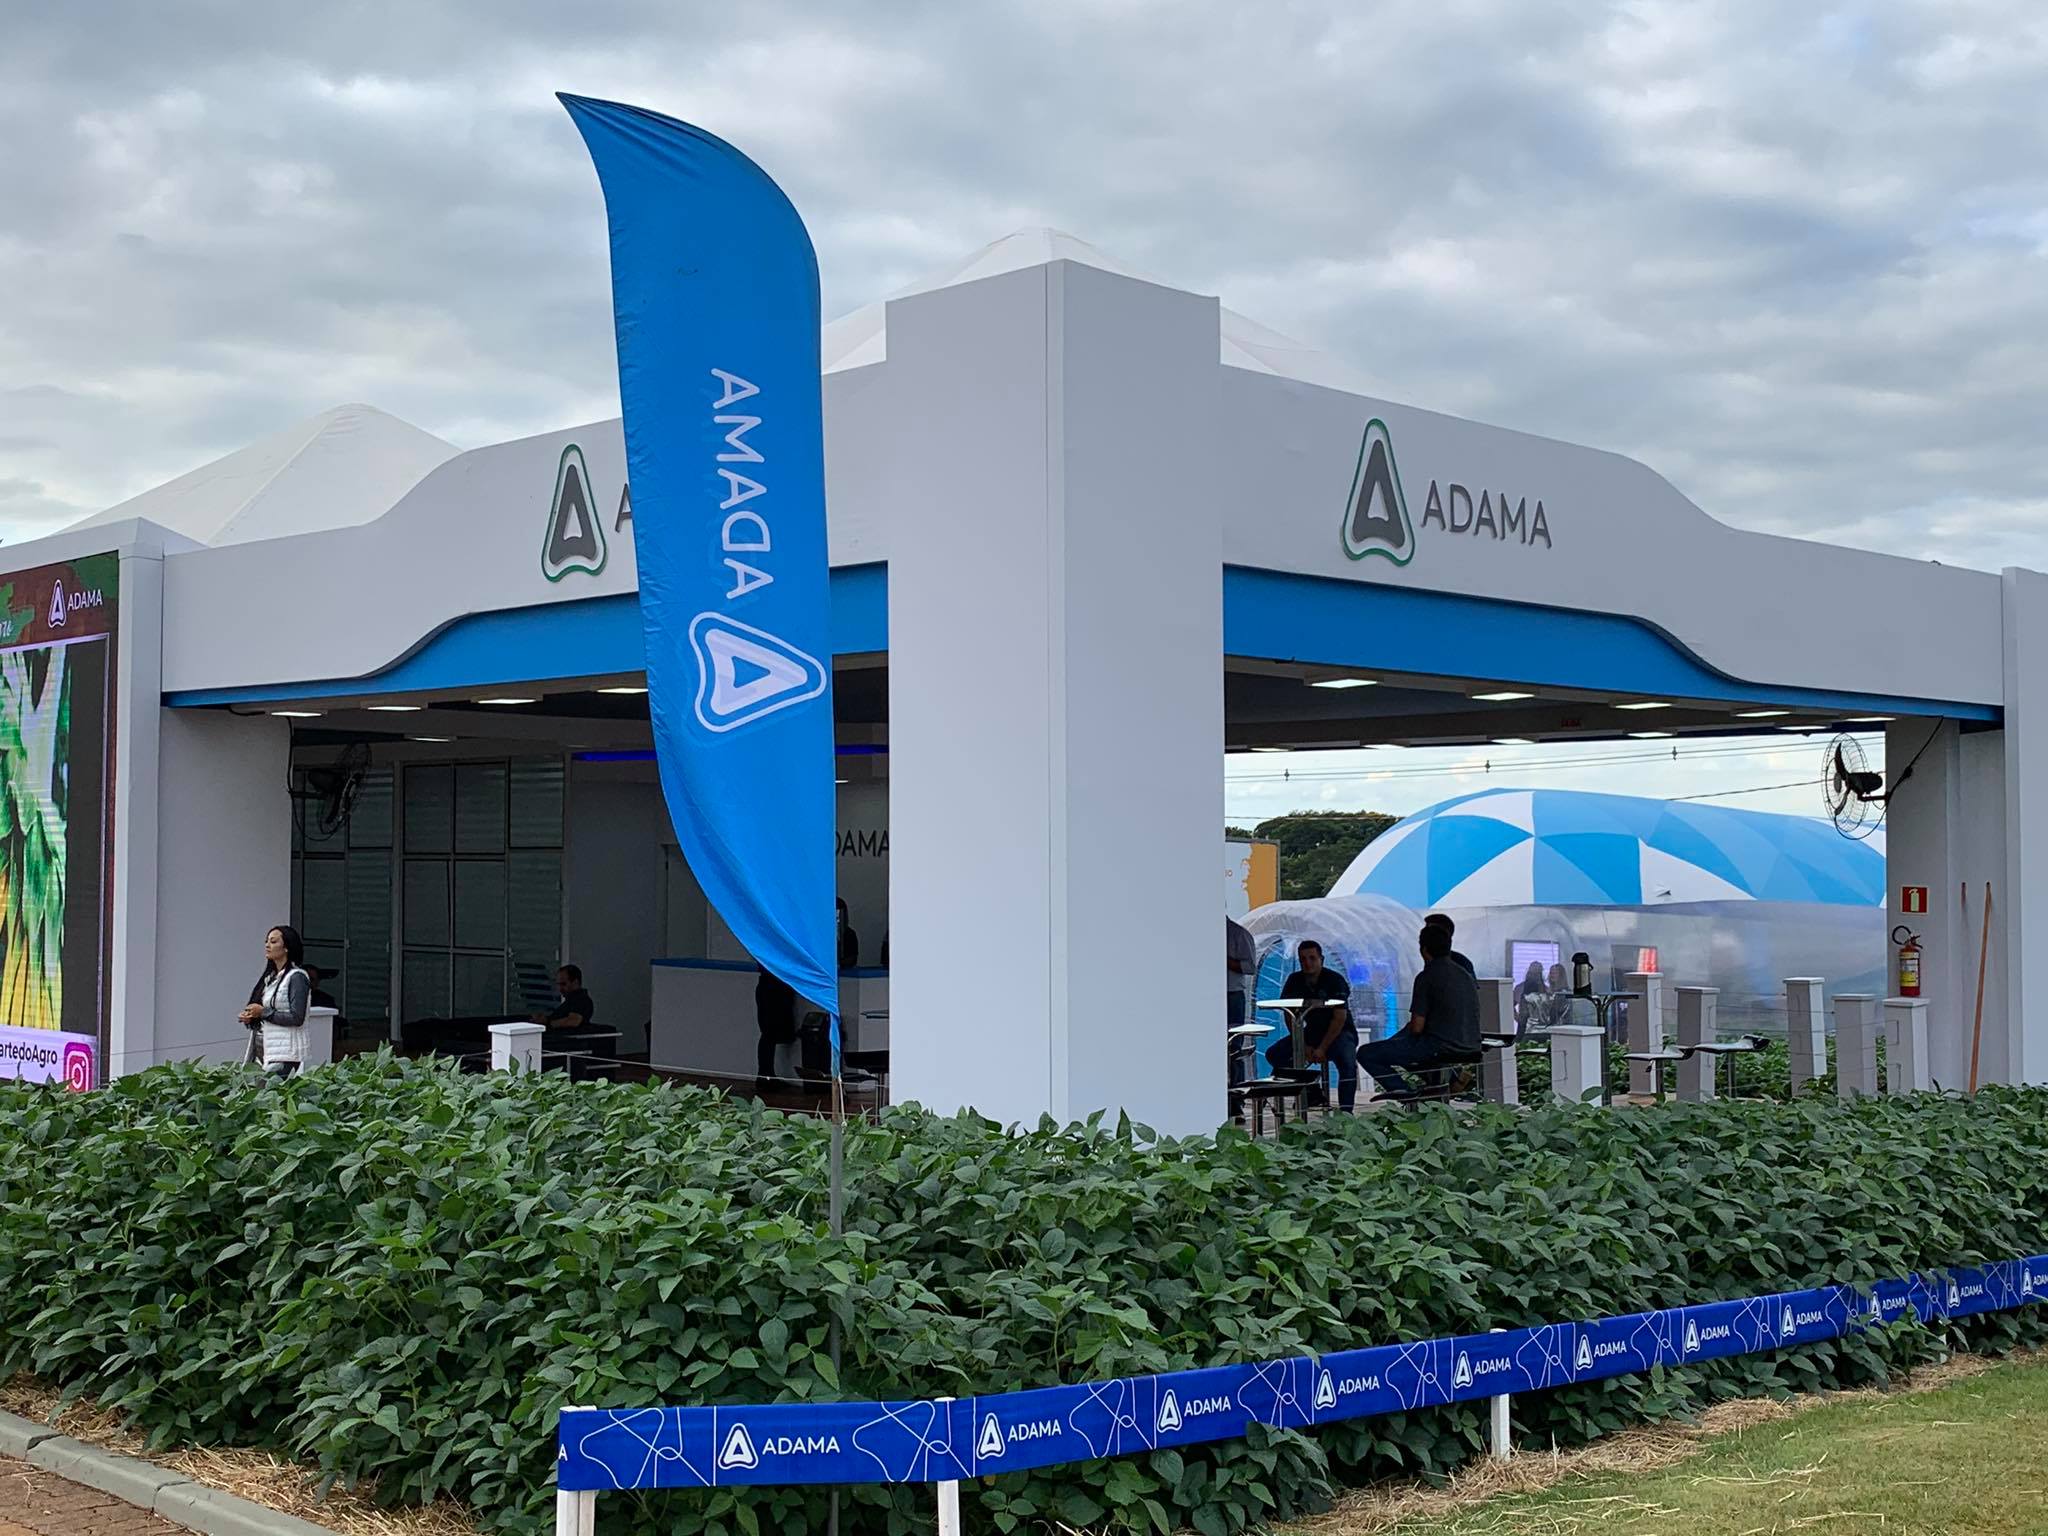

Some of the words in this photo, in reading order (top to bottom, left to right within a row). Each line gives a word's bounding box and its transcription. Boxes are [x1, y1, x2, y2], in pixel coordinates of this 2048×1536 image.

[1420, 479, 1552, 549] ADAMA
[67, 588, 103, 612] ADAMA
[1960, 1284, 1983, 1297] ADAMA
[1882, 1296, 1906, 1310] ADAMA
[1795, 1311, 1823, 1326] ADAMA
[1700, 1325, 1730, 1341] ADAMA
[1593, 1340, 1627, 1358] ADAMA
[1474, 1357, 1512, 1375] ADAMA
[1337, 1376, 1381, 1395] ADAMA
[1183, 1396, 1232, 1417] ADAMA
[1007, 1419, 1062, 1443] ADAMA
[762, 1436, 841, 1456] ADAMA
